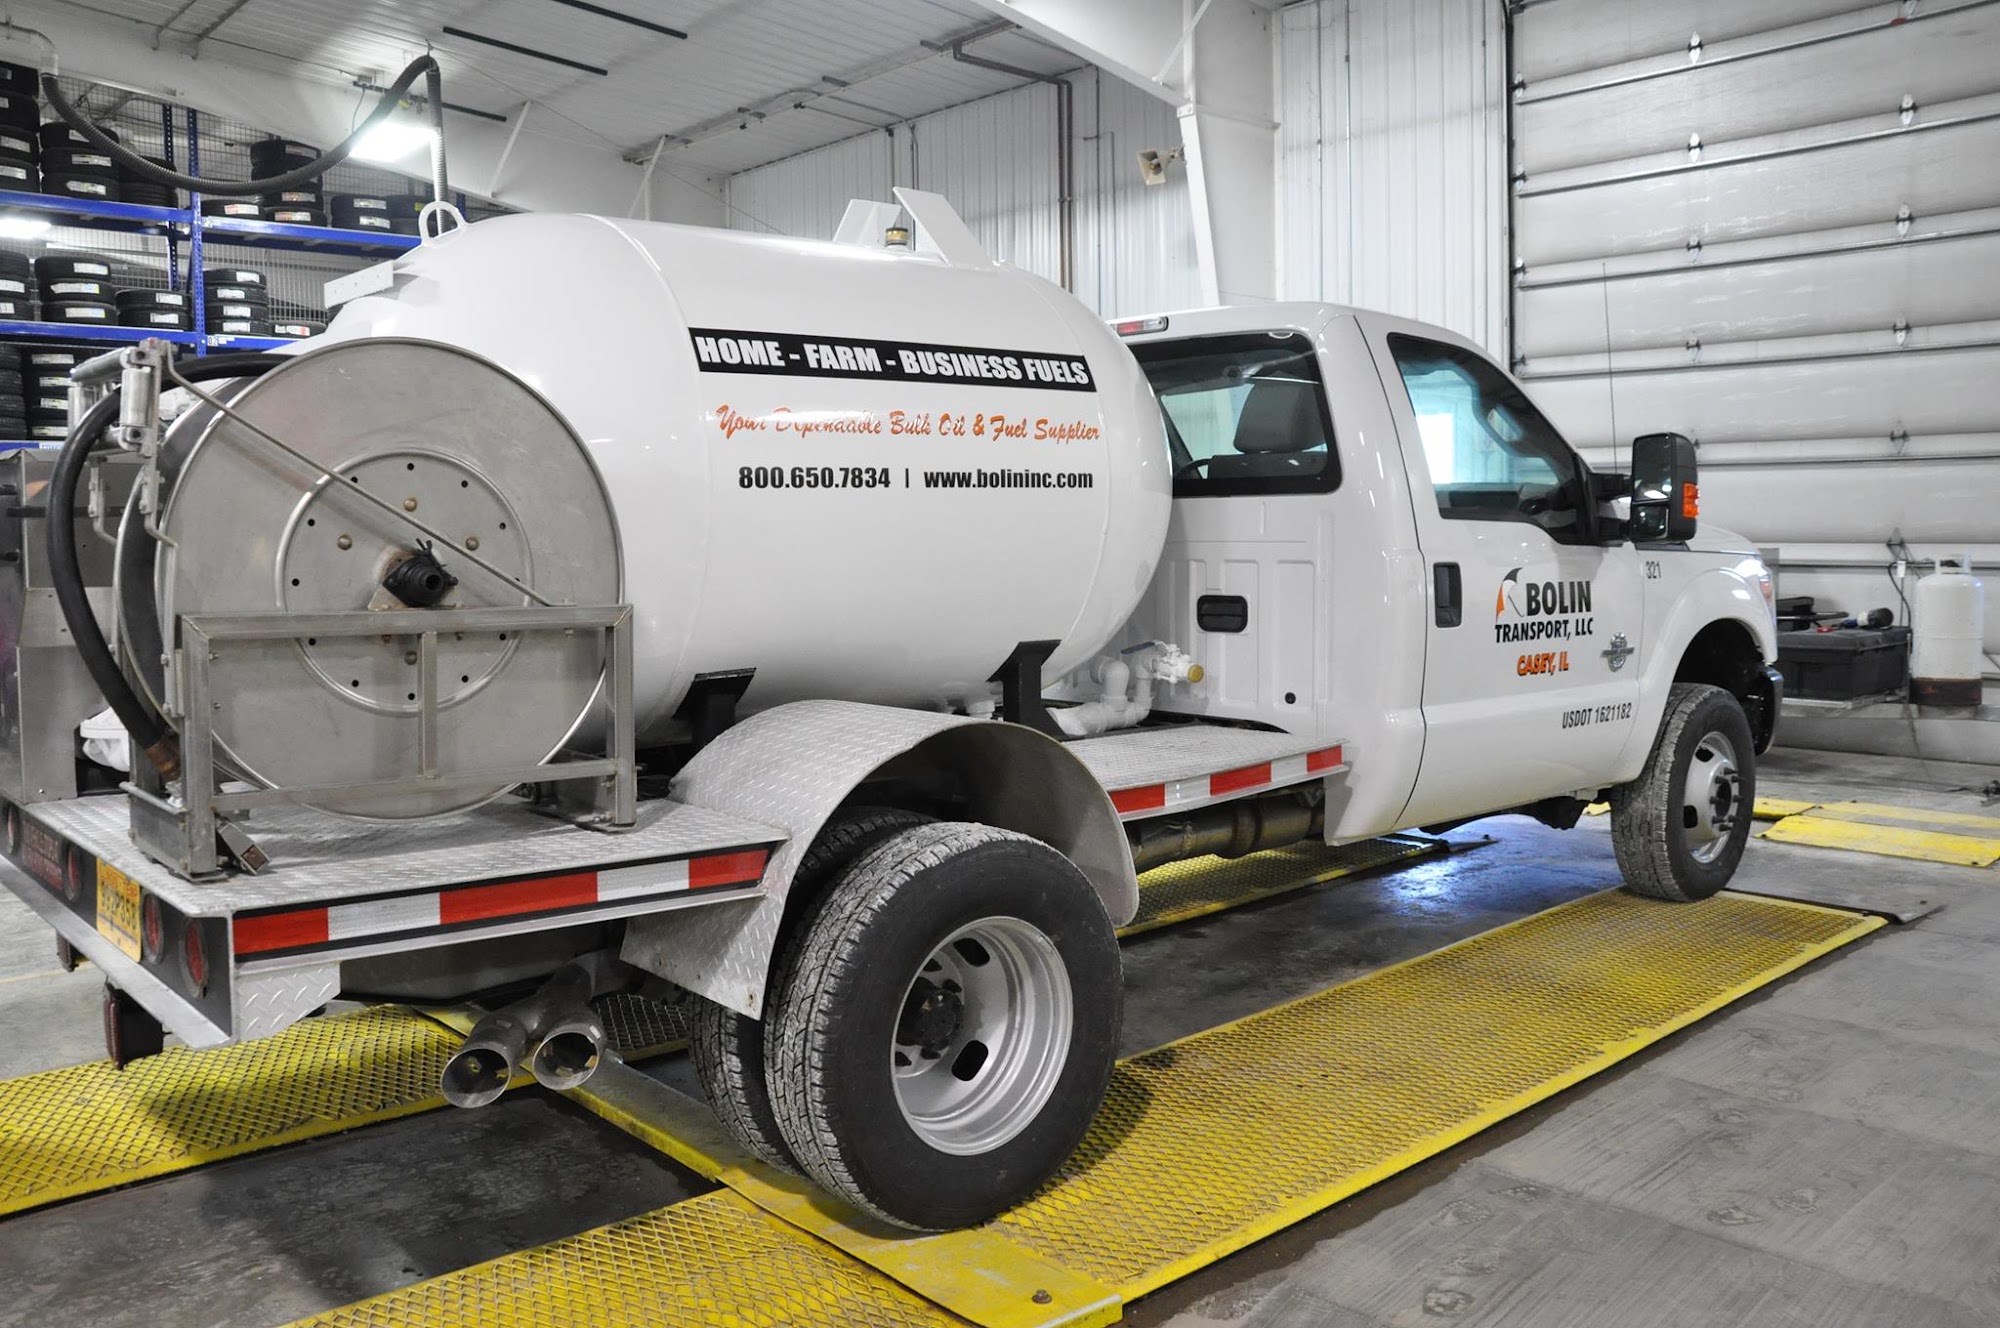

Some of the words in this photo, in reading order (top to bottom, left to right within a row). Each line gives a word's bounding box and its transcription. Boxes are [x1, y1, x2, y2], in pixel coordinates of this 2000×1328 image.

[695, 336, 785, 367] HOME
[803, 343, 882, 373] FARM
[898, 349, 1023, 381] BUSINESS
[1023, 358, 1089, 385] FUELS
[716, 404, 766, 439] Your
[889, 410, 932, 435] Bulk
[938, 413, 966, 436] Oil
[972, 413, 985, 437] &
[990, 415, 1028, 441] Fuel
[1034, 418, 1100, 444] Supplier
[738, 466, 891, 489] 800.650.7834
[924, 468, 1094, 489] www.bolininc.com
[1646, 561, 1662, 579] 321
[1526, 580, 1592, 616] BOLIN
[1495, 619, 1571, 643] TRANSPORT,
[1575, 617, 1594, 637] LLC
[1517, 652, 1556, 676] CASEY,
[1559, 651, 1570, 672] IL
[1562, 708, 1593, 729] USDOT
[1595, 703, 1632, 724] 1621182
